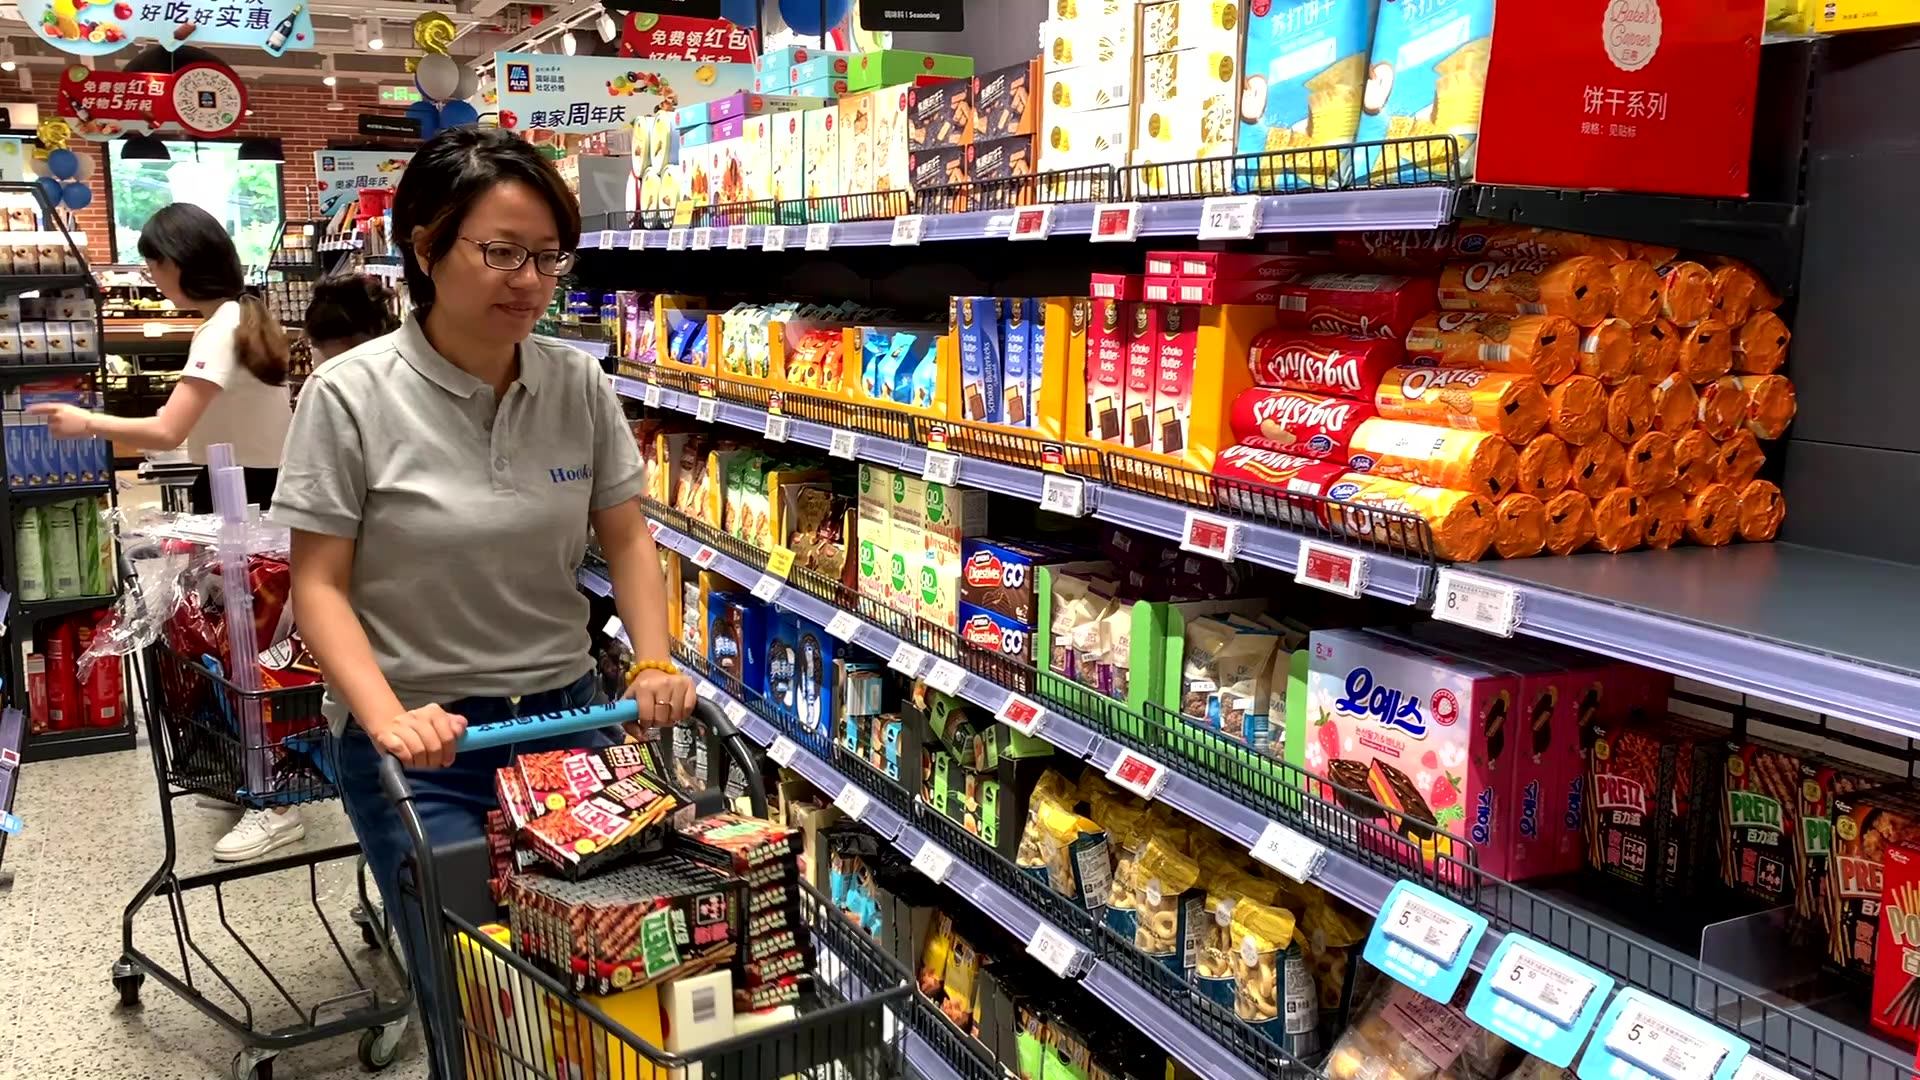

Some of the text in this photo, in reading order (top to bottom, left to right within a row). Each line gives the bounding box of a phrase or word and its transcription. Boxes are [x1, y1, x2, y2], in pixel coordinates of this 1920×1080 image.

[141, 2, 272, 29] 好吃好实惠
[909, 11, 940, 20] Seasoning
[650, 28, 748, 50] 免费领红包
[510, 79, 528, 87] ALDI
[530, 102, 626, 128] 奥家周年庆
[1583, 85, 1668, 120] 饼干系列
[1161, 345, 1183, 356] Schoko
[1268, 350, 1361, 391] Digestives
[1402, 369, 1483, 401] OATIES
[1253, 397, 1350, 433] Digestives
[969, 566, 1000, 582] Digestives
[967, 629, 999, 645] Digestives
[1336, 667, 1426, 735] 오예스
[1599, 776, 1643, 807] PRETZ
[1732, 793, 1780, 827] PRETZ
[1841, 858, 1884, 892] PRE
